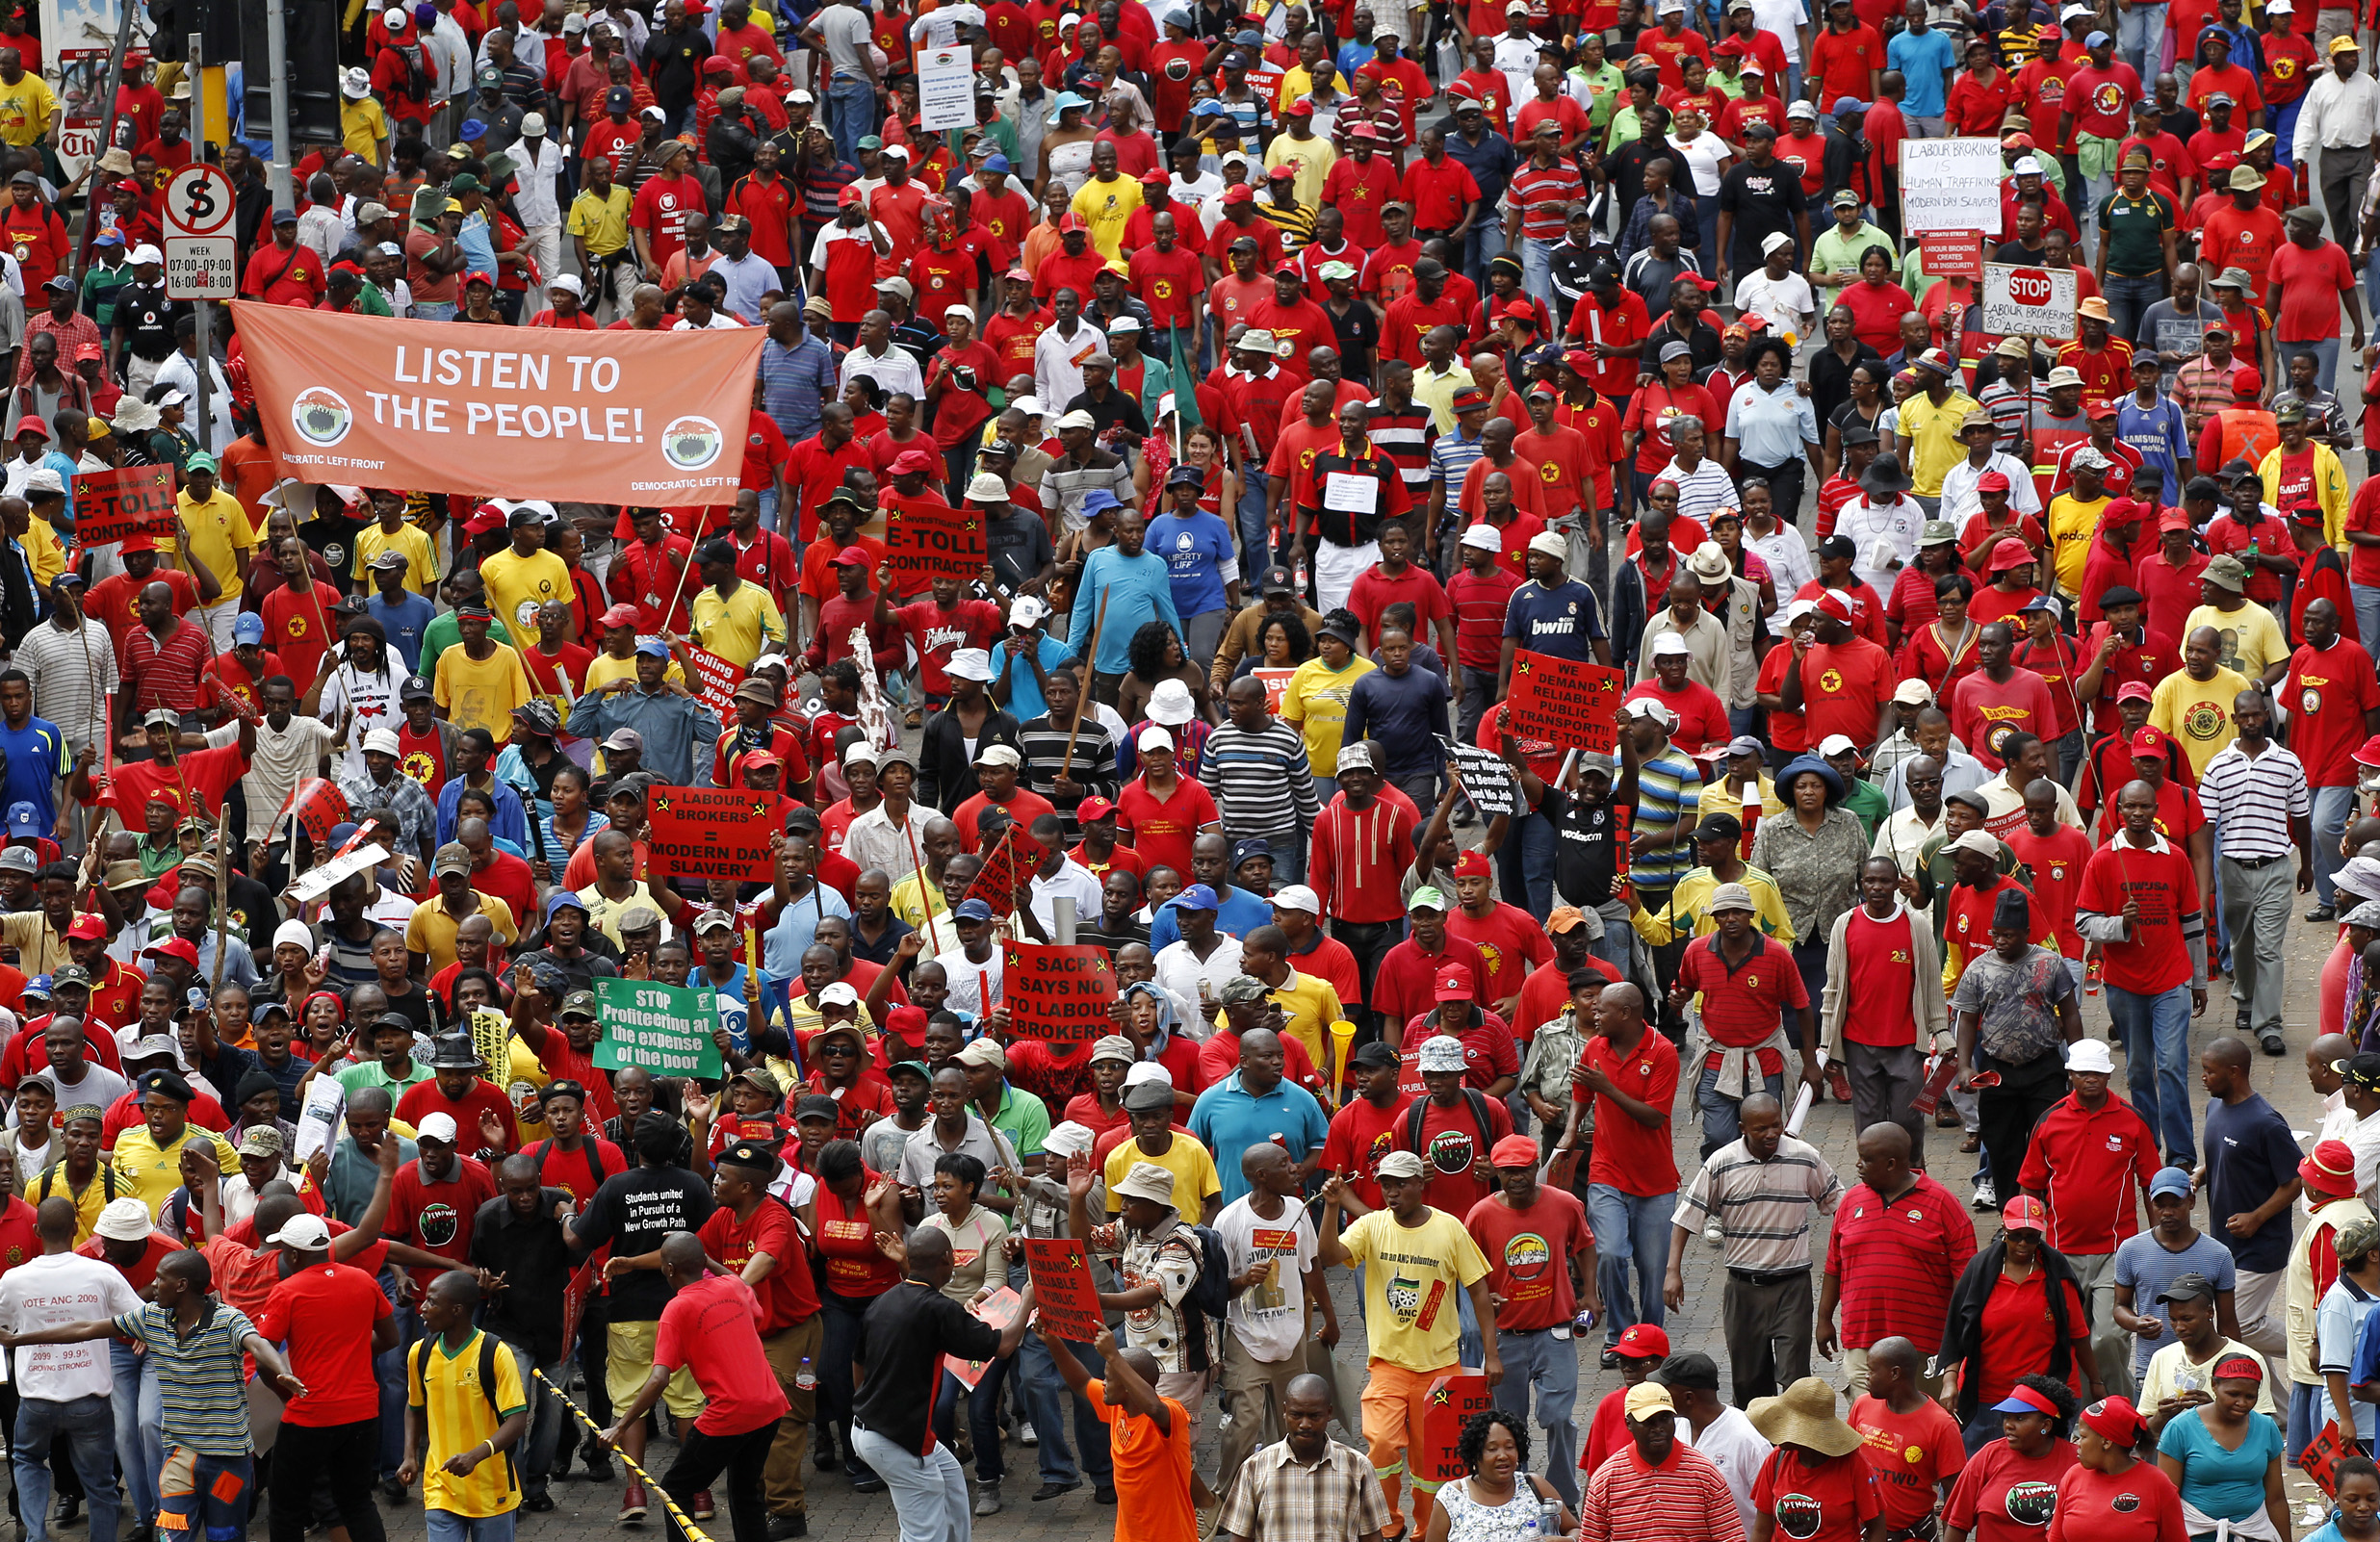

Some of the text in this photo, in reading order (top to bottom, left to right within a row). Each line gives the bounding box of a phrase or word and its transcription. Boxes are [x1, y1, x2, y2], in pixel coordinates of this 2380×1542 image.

[1244, 72, 1273, 84] bour
[62, 133, 94, 157] Th
[1909, 141, 1998, 159] LABOUR BROKING
[1934, 160, 1951, 172] IS
[1905, 176, 1942, 189] HUMAN
[1906, 195, 1999, 208] MODERN DAY SLAVERY
[1907, 215, 1933, 230] BAN
[190, 246, 211, 255] WEEK
[169, 259, 231, 271] 07:00-09:00
[1940, 261, 1975, 270] INSECURITY
[170, 275, 231, 288] 16:008:00
[2010, 276, 2051, 297] STOP
[1983, 301, 2075, 323] LABOUR BROKERING
[395, 346, 620, 393] LISTEN TO
[365, 390, 644, 444] THE PEOPLE!
[2124, 435, 2165, 446] SAMSUNG
[2141, 445, 2166, 453] mobile
[326, 455, 385, 470] LEFT FRONT
[93, 479, 152, 494] INVESTIGATE
[632, 477, 697, 491] DEMOCRATIC
[699, 476, 723, 487] LEFT
[2280, 483, 2309, 495] SADTU
[76, 491, 173, 521] E-TOLL
[80, 517, 177, 542] CONTRACTS
[905, 515, 963, 530] INVESTIGATE
[887, 527, 985, 554] E-TOLL
[887, 554, 985, 575] CONTRACTS
[1168, 553, 1203, 561] LIBERTY
[1532, 618, 1574, 635] bwin
[922, 625, 967, 655] Billabong
[688, 647, 734, 679] Tolling
[1559, 663, 1579, 676] WE
[697, 668, 736, 694] uteng
[1539, 673, 1597, 693] DEMAND
[1533, 685, 1600, 707] RELIABLE
[1539, 701, 1590, 719] PUBLIC
[1985, 707, 2025, 718] SATAWU
[1519, 709, 1610, 736] TRANSPORT!!
[1514, 722, 1611, 752] NOT E-TOLLS
[1455, 758, 1480, 771] Lower
[1462, 773, 1510, 786] No Benefits
[683, 792, 745, 807] LABOUR
[1470, 788, 1513, 801] and No Job
[1478, 800, 1513, 815] Security.
[676, 809, 749, 823] BROKERS
[1984, 818, 2006, 828] OSATU
[651, 842, 772, 861] MODERN DAY
[317, 866, 339, 883] bour
[670, 860, 753, 877] SLAVERY
[982, 863, 1006, 885] BLIC
[1036, 957, 1088, 972] SACP
[1020, 976, 1104, 995] SAYS NO
[635, 989, 671, 1010] STOP
[1008, 995, 1113, 1017] TO LABOU
[603, 1003, 711, 1035] Profiteering at
[481, 1014, 492, 1058] AWAY
[1017, 1018, 1109, 1041] BROKERS
[611, 1025, 703, 1051] the expense
[494, 1021, 503, 1084] ednesday
[616, 1045, 699, 1069] of the poor
[1402, 1082, 1427, 1092] PUBLI
[625, 1189, 684, 1204] Students united
[630, 1208, 637, 1218] in
[638, 1203, 665, 1216] Pursuit
[666, 1202, 675, 1213] of
[625, 1217, 686, 1232] New Growth Path
[1031, 1244, 1050, 1257] WE
[841, 1262, 861, 1271] living
[1029, 1258, 1070, 1273] DEMAND
[1380, 1251, 1439, 1269] am an ANC Volunteer
[1033, 1273, 1078, 1290] RELIABLE
[22, 1294, 98, 1308] VOTE ANC 2009
[1042, 1290, 1076, 1306] PUBLIC
[1397, 1309, 1417, 1318] ANC
[63, 1349, 90, 1359] 99.9%
[57, 1359, 92, 1372] STRONGER
[2226, 1362, 2258, 1375] COSATU
[1462, 1399, 1491, 1409] DEM
[1437, 1463, 1472, 1477] NO
